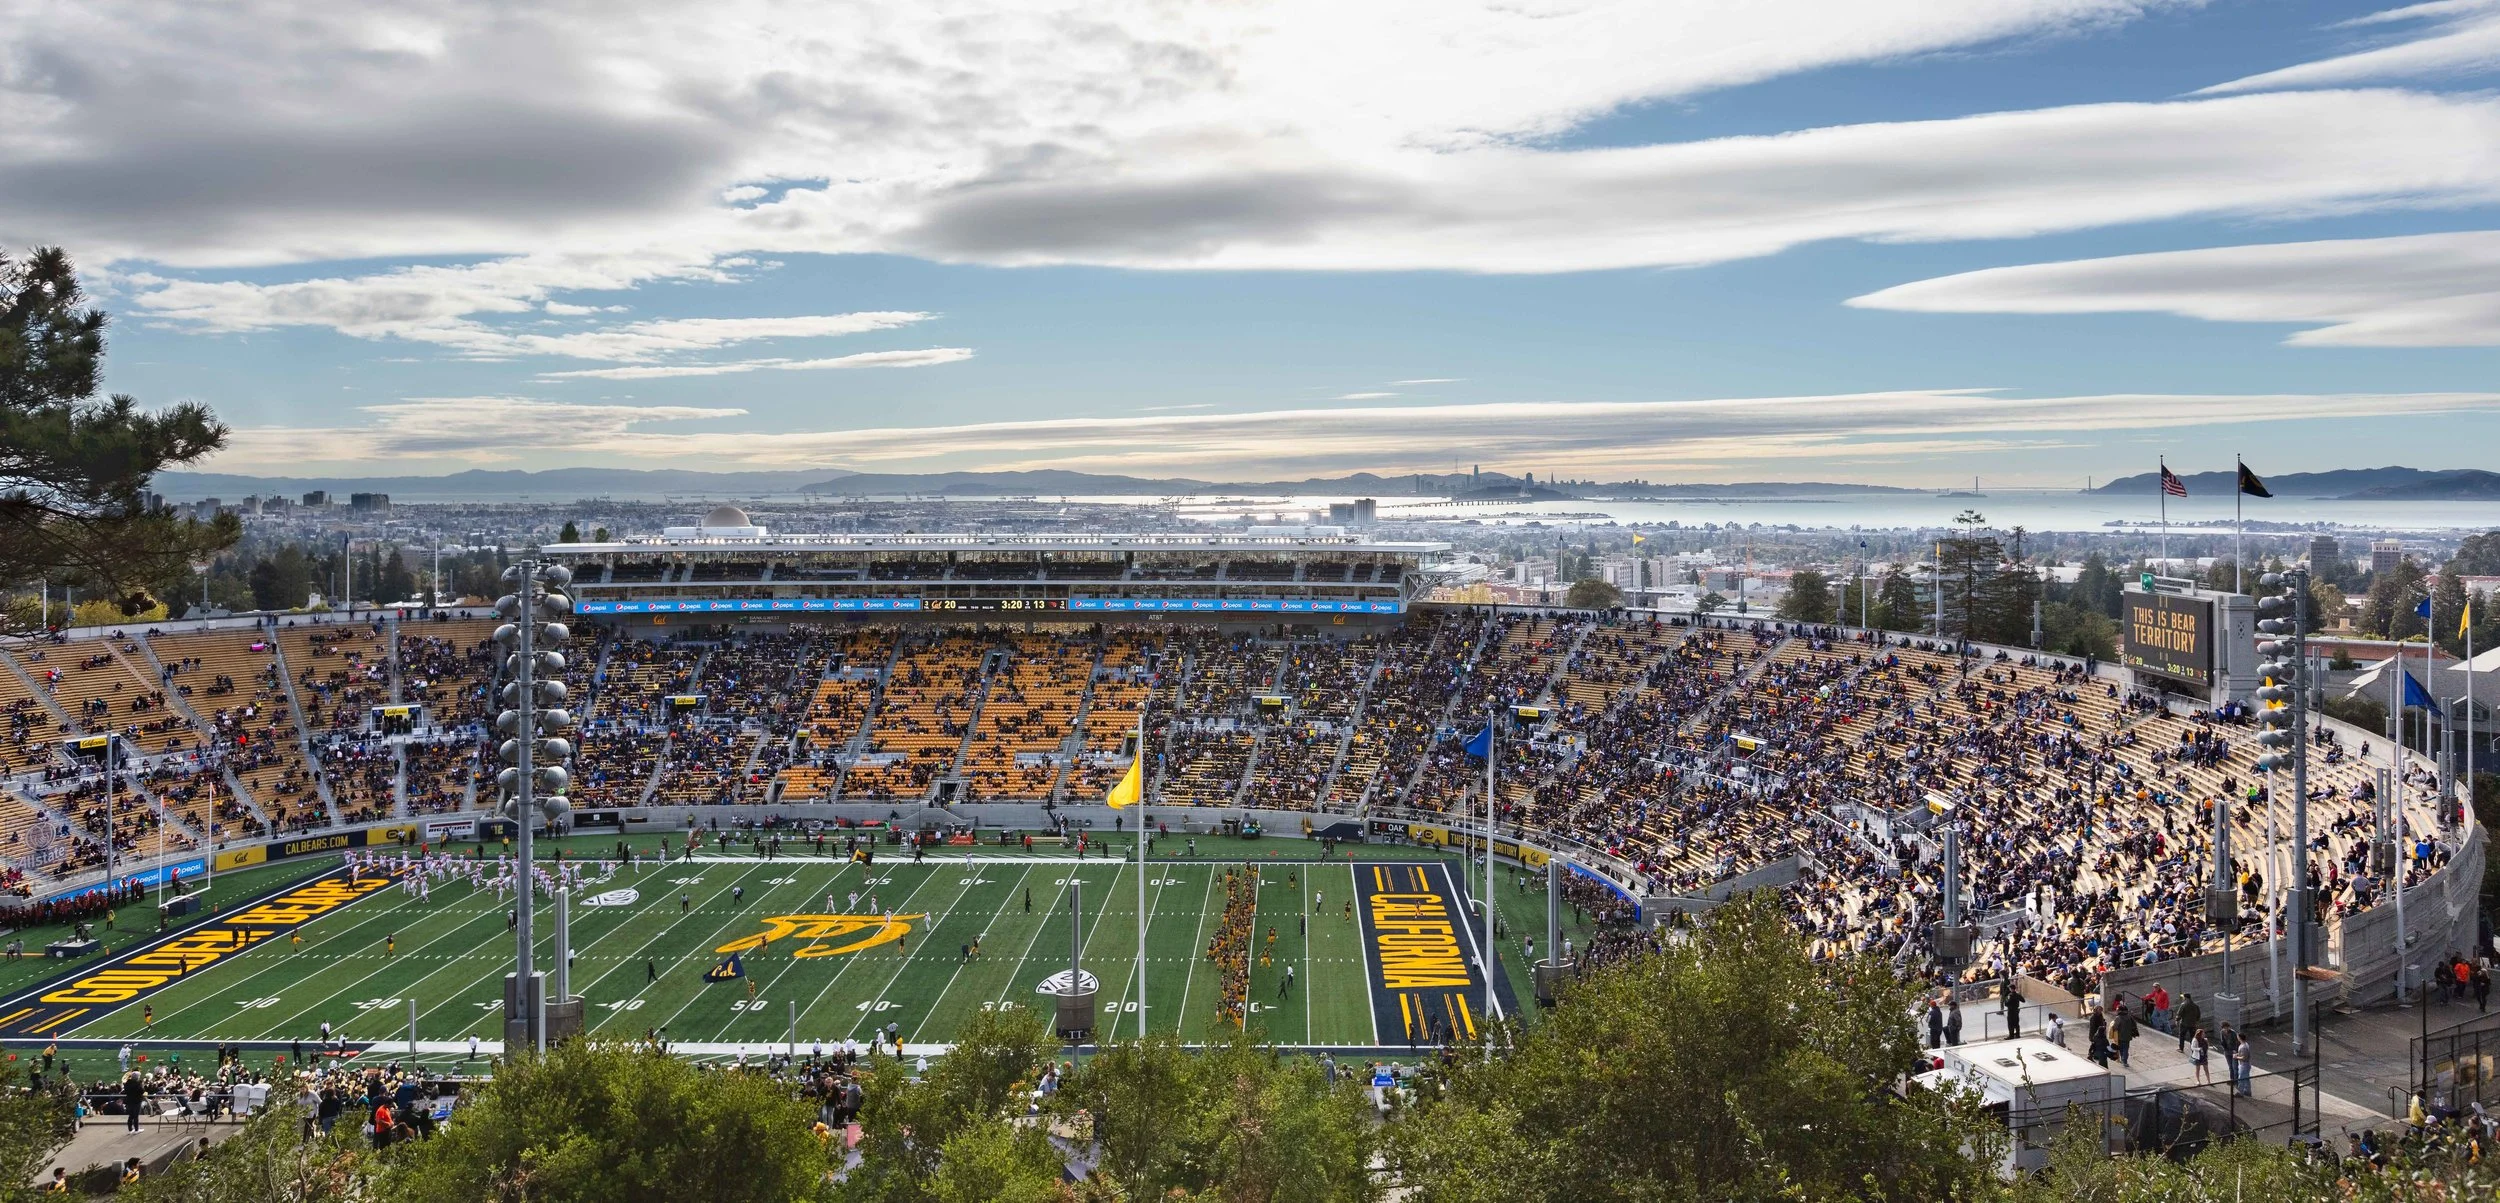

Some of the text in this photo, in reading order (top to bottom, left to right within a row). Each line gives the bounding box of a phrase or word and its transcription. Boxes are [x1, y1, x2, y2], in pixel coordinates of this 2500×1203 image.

[944, 601, 956, 609] 20
[1002, 601, 1022, 609] 3:20
[1034, 601, 1045, 609] 13
[653, 615, 666, 624] Cal
[1333, 614, 1346, 624] Cal
[2133, 607, 2195, 631] THIS IS BEAR
[2133, 624, 2195, 653] TERRITORY
[2136, 657, 2143, 666] 20
[2167, 663, 2181, 674] 3:20
[2186, 667, 2194, 677] 13
[1388, 824, 1404, 832] OAK
[285, 835, 349, 855] CALBEARS.COM
[1450, 833, 1464, 846] THIS
[1493, 841, 1518, 857] ERRITORY
[17, 847, 66, 870] Allstate
[234, 852, 248, 864] Cal
[1530, 851, 1539, 863] Cal
[181, 863, 201, 875] pepsi
[679, 877, 705, 885] 30
[770, 877, 796, 885] 40
[40, 878, 391, 1003] GOLDEN BEARS
[715, 914, 927, 959] Cal
[1370, 894, 1472, 989] CALIFORNIA
[711, 961, 738, 977] Cal
[242, 998, 280, 1009] 10
[359, 998, 401, 1009] 20
[608, 999, 646, 1011] 40
[730, 1001, 768, 1011] 50
[856, 1001, 891, 1011] 40
[1104, 1002, 1139, 1013] 20
[1068, 1030, 1083, 1039] TT
